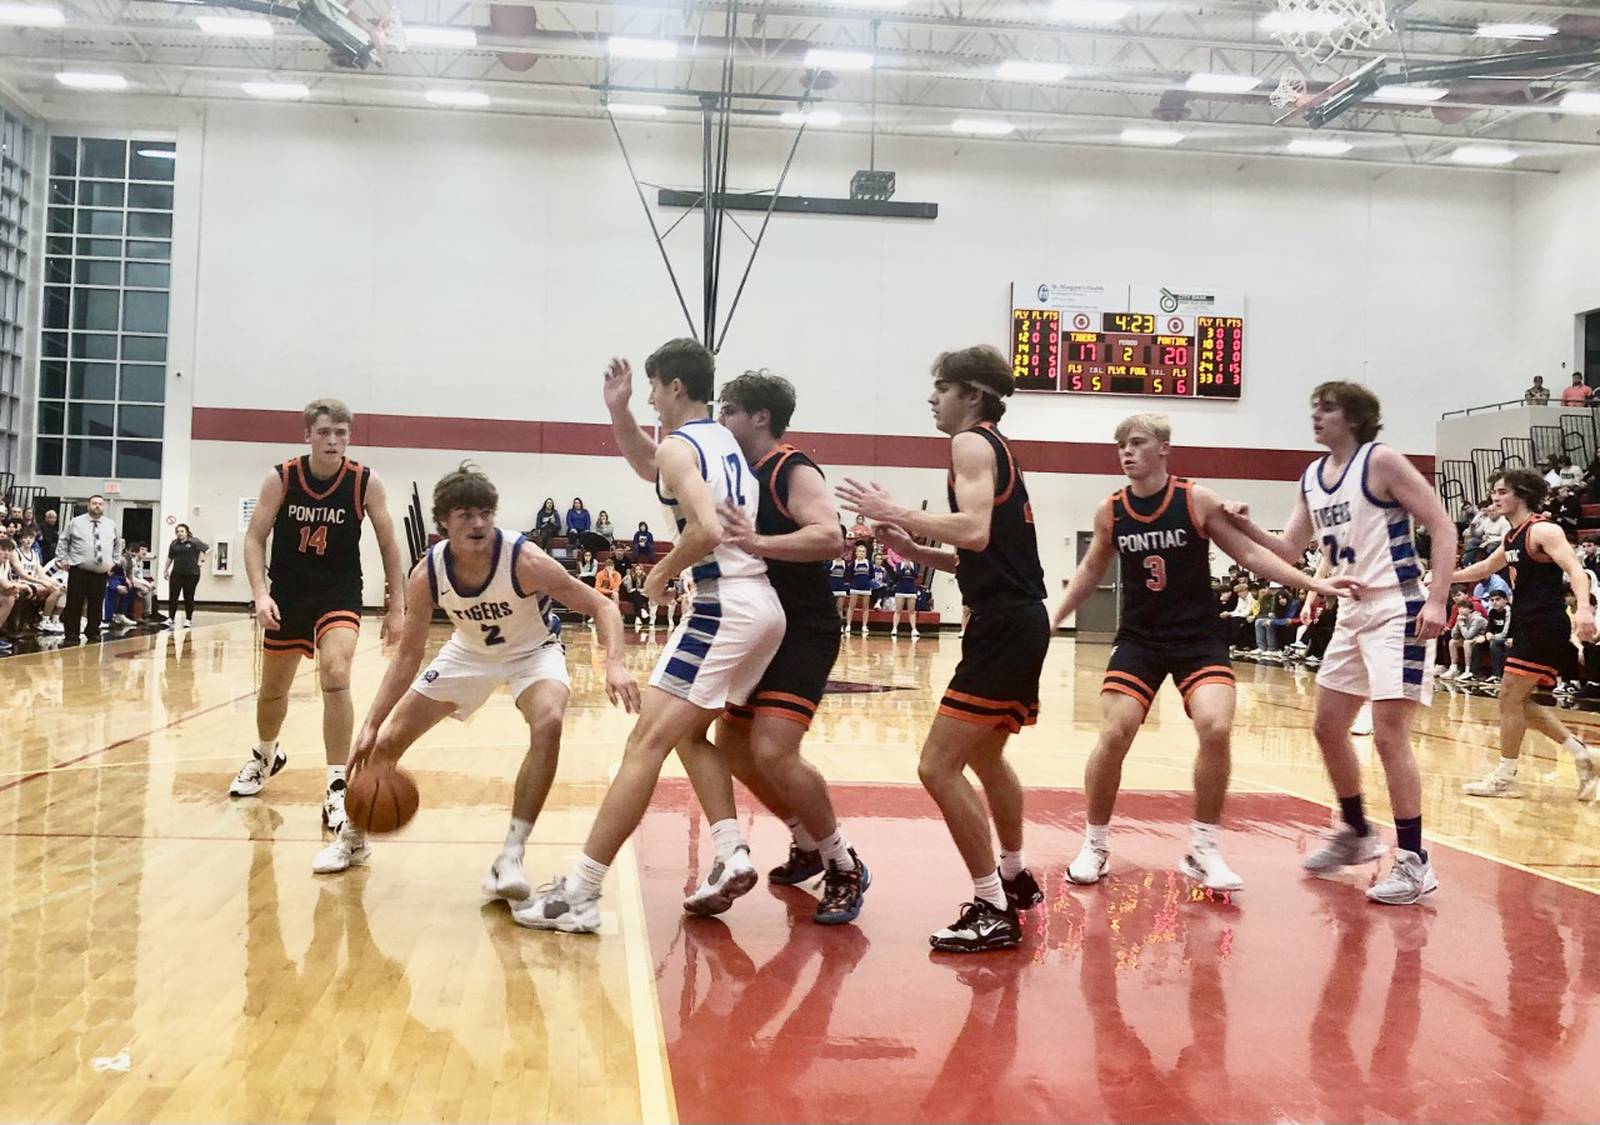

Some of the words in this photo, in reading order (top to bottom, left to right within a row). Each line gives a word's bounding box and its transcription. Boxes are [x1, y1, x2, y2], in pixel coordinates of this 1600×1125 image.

[1015, 311, 1029, 319] PLY
[1032, 311, 1041, 320] FL
[1043, 312, 1058, 320] PTS
[1022, 320, 1029, 330] 2
[1050, 321, 1057, 331] 4
[1115, 315, 1153, 333] 4:23
[1199, 317, 1213, 326] PLY
[1216, 318, 1225, 327] FL
[1227, 319, 1241, 328] PTS
[1018, 332, 1029, 343] 12
[1032, 332, 1040, 343] 0
[1050, 332, 1057, 343] 0
[1070, 333, 1097, 342] TIGERS
[1207, 327, 1214, 338] 3
[1233, 329, 1240, 339] 0
[1157, 336, 1188, 346] PONTIAC
[1215, 339, 1224, 350] 0
[1080, 343, 1096, 361] 17
[1123, 347, 1133, 361] 2
[1164, 347, 1187, 365] 20
[1216, 351, 1224, 361] 2
[1232, 351, 1240, 362] 0
[1014, 354, 1029, 366] 23
[1031, 355, 1040, 366] 0
[1049, 355, 1056, 366] 5
[1013, 366, 1029, 377] 24
[1048, 367, 1056, 378] 0
[1067, 363, 1082, 373] FLS
[1107, 365, 1127, 375] PLYR
[1130, 366, 1148, 376] FOUL
[1172, 368, 1187, 377] FLS
[1199, 361, 1213, 372] 24
[1229, 363, 1240, 374] 15
[1072, 375, 1081, 390] 5
[1092, 376, 1101, 391] 5
[1153, 378, 1163, 393] 5
[1200, 373, 1213, 384] 33
[1215, 373, 1223, 384] 0
[1232, 374, 1240, 385] 3
[1176, 379, 1186, 394] 6
[721, 453, 746, 506] 12
[288, 504, 346, 524] PONTIAC
[1313, 501, 1351, 529] TIGERS
[298, 526, 328, 556] 14
[1118, 528, 1187, 553] PONTIAC
[1143, 555, 1167, 591] 3
[453, 601, 513, 621] TIGERS
[481, 623, 506, 647] 2
